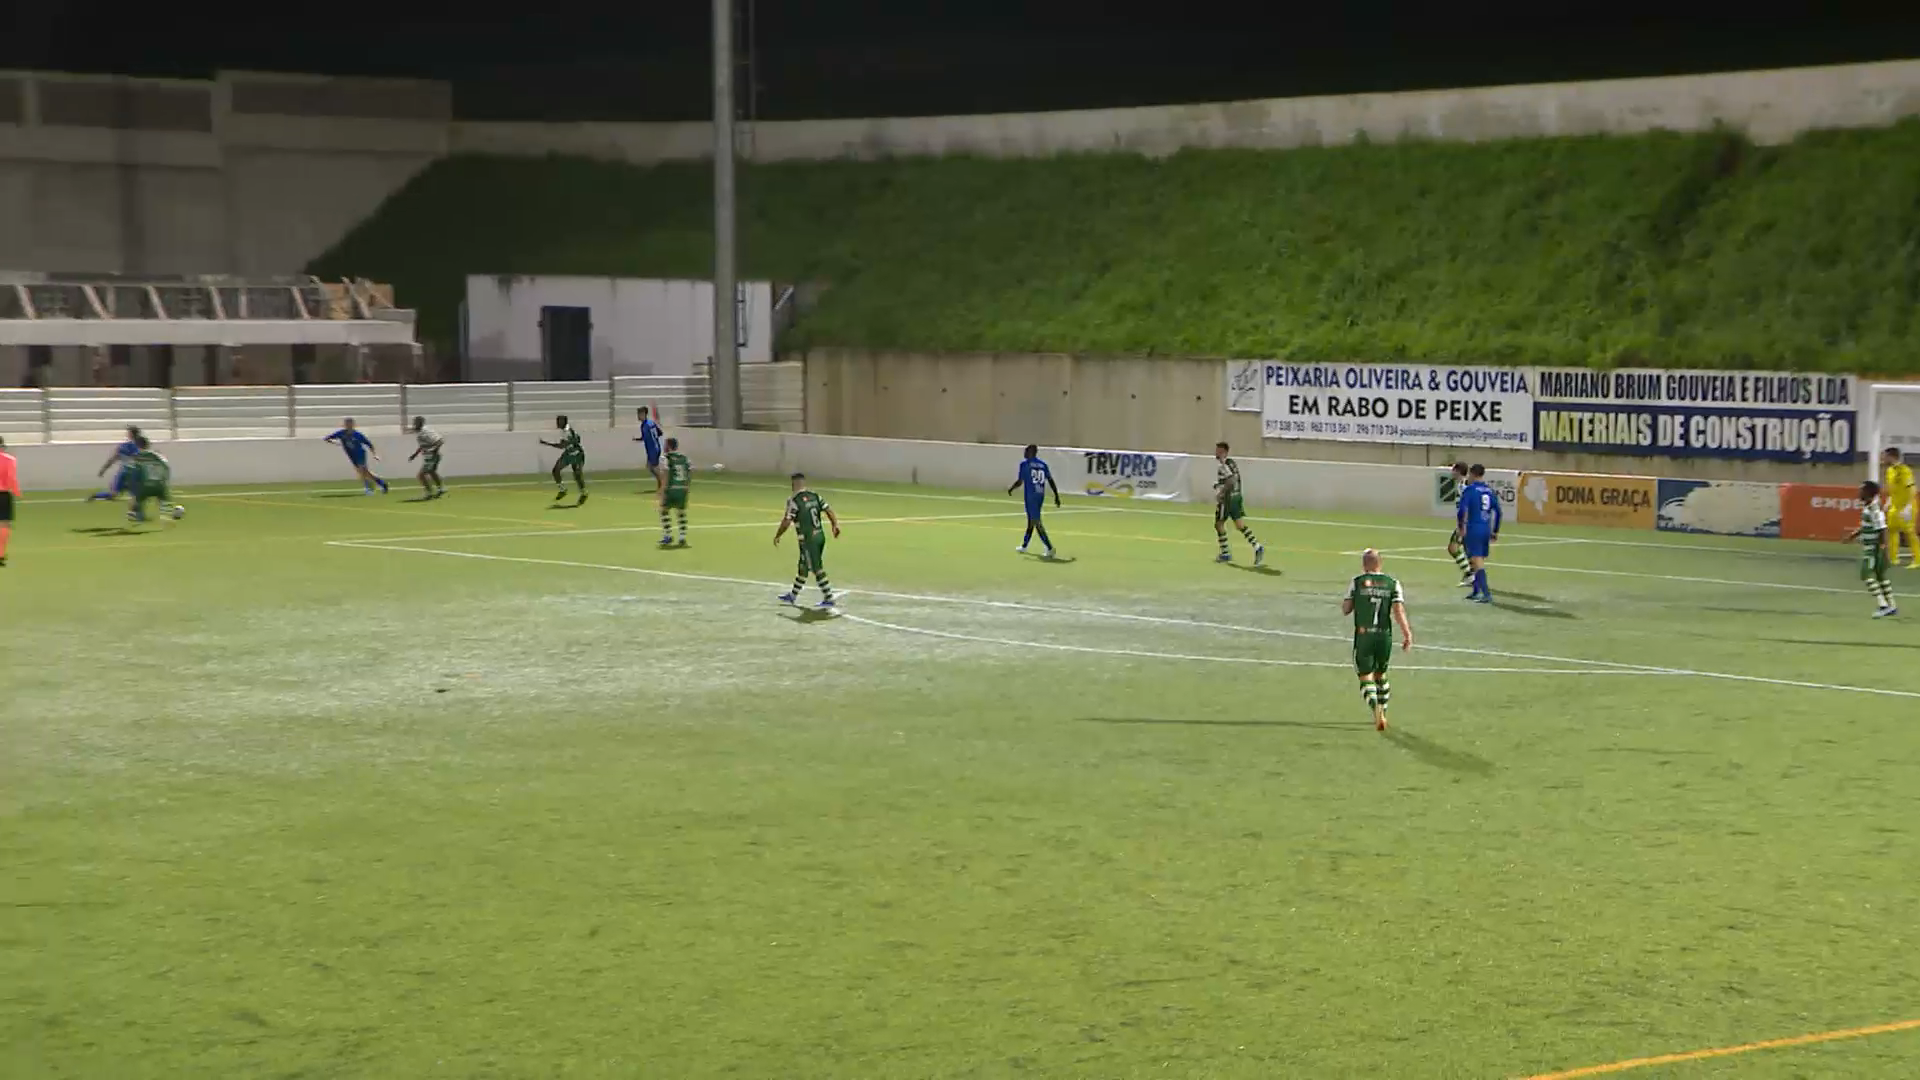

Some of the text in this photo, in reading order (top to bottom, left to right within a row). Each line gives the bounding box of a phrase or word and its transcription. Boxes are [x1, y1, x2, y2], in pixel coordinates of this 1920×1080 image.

[1266, 366, 1340, 388] PEIXARIA
[1345, 367, 1423, 390] OLIVEIRA
[1428, 369, 1440, 391] &
[1446, 370, 1529, 393] GOUVEIA
[1540, 372, 1850, 405] MARIANO BRUM GOUVEIA E FILHOS LDA
[1289, 395, 1502, 422] EM RABO DE PEIXE
[1539, 410, 1850, 459] MATERIAIS DE CONSTRUÇÃO
[1481, 494, 1491, 511] 9
[1556, 486, 1651, 512] DONA GRAÇA
[1811, 496, 1863, 511] expe
[810, 507, 820, 528] 6
[1370, 597, 1382, 625] 7
